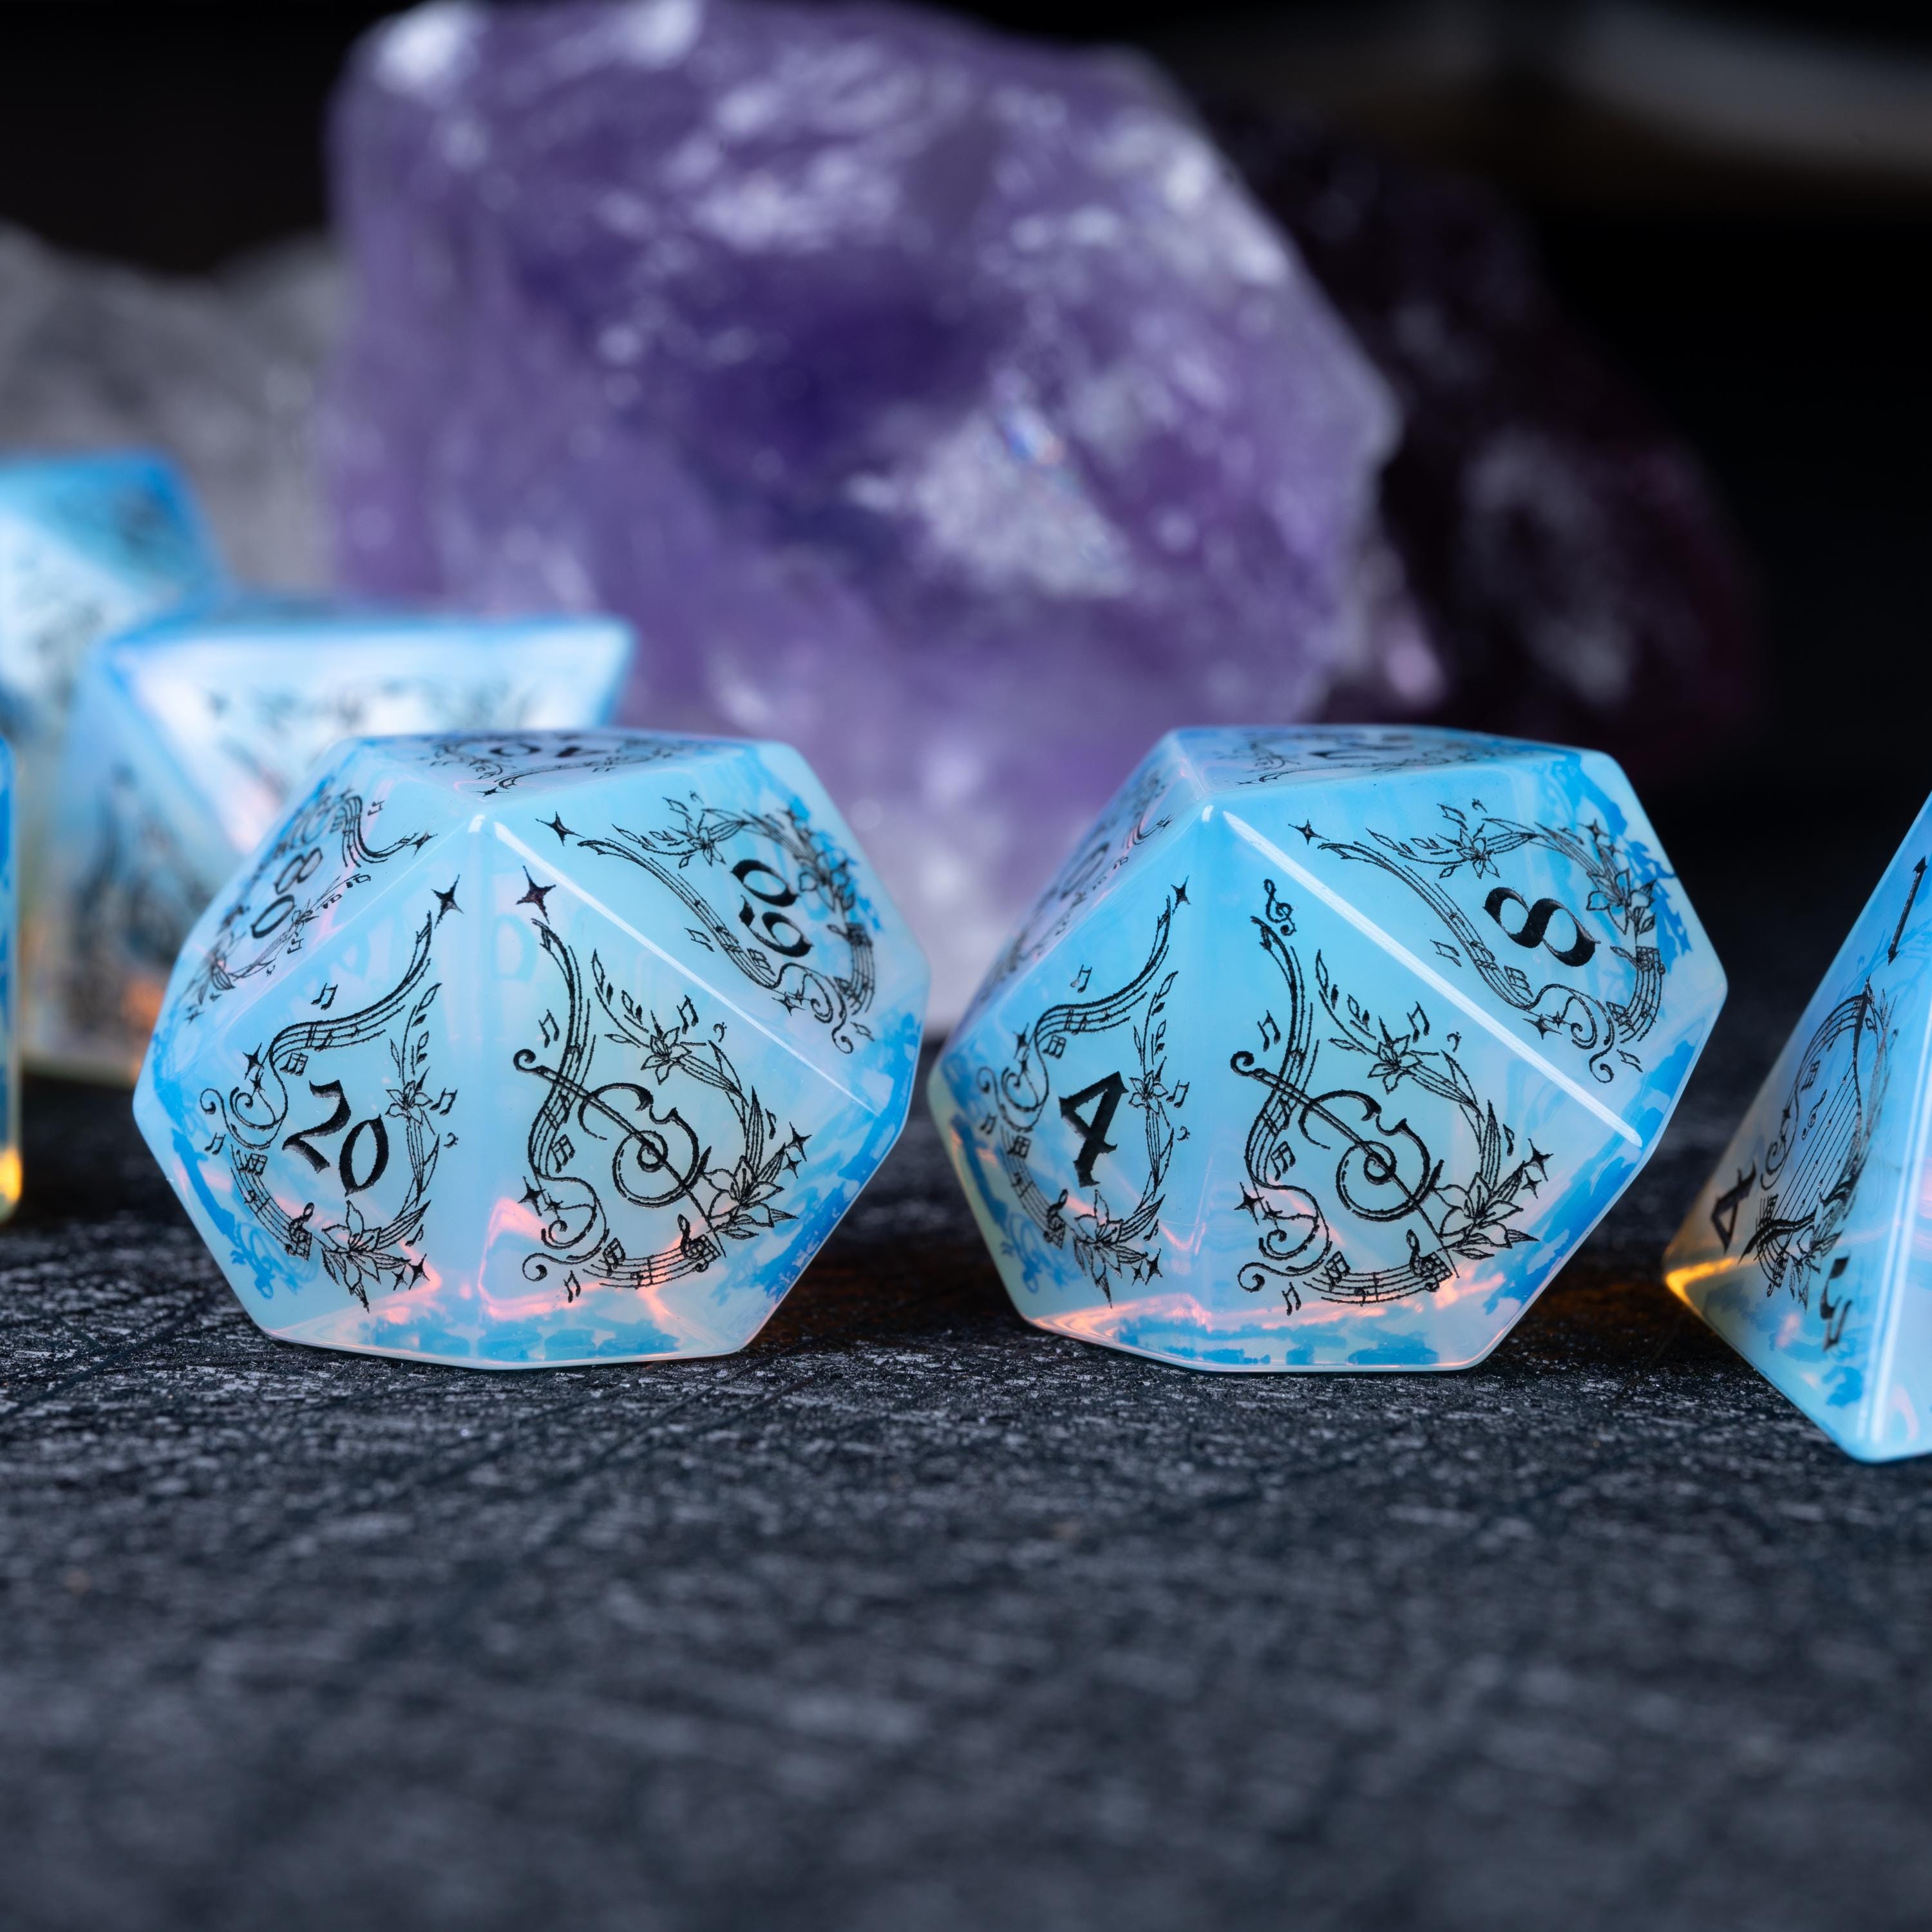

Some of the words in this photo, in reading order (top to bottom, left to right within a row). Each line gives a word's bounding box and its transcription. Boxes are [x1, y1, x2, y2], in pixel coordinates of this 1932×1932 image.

[729, 858, 814, 958] 60
[1483, 886, 1600, 967] 8
[283, 1079, 388, 1197] 20
[1059, 1071, 1128, 1188] 4
[1710, 1160, 1757, 1255] 4
